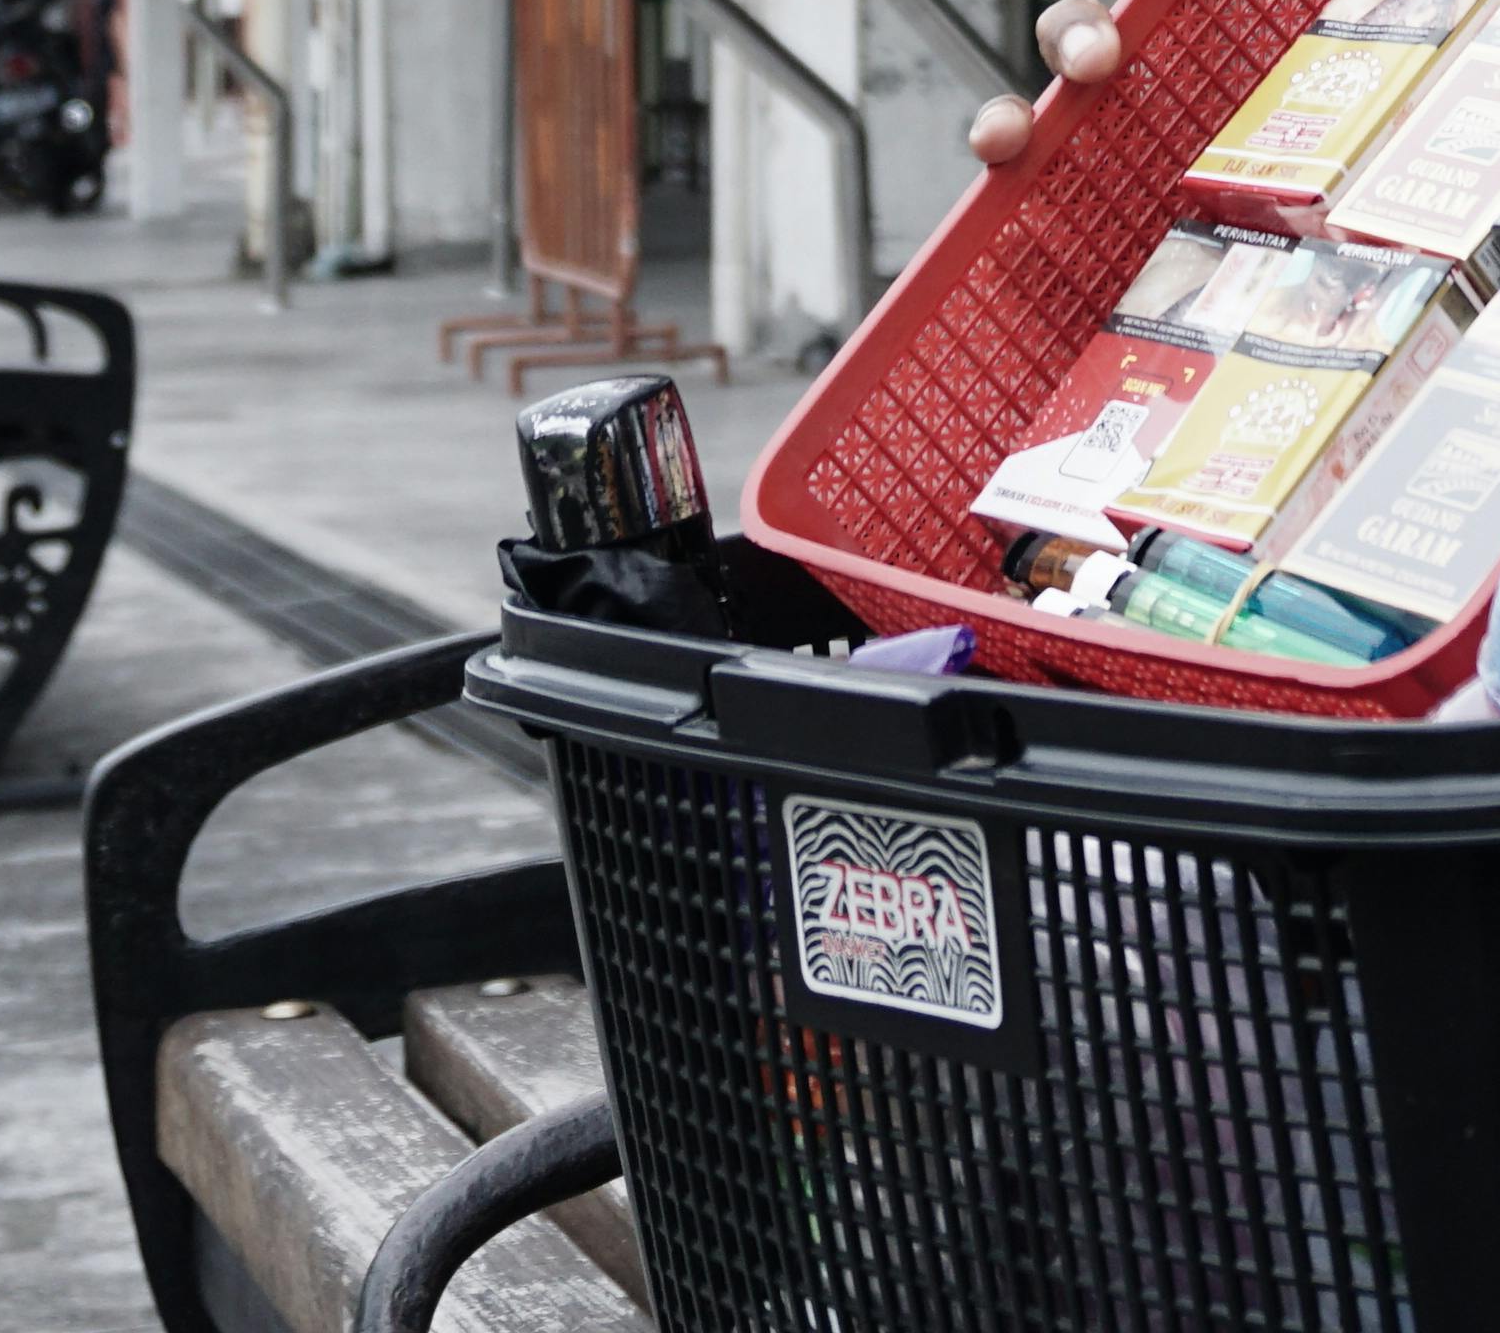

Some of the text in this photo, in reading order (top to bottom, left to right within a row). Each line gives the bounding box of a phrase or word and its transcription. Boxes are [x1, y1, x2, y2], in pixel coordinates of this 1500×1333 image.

[1407, 157, 1481, 189] GUDANG
[1375, 174, 1480, 220] GARAM
[1213, 224, 1289, 249] PERINGATAN
[1336, 242, 1414, 266] PERINGATAN
[1356, 513, 1465, 569] GARAM
[816, 859, 972, 952] ZEBRA
